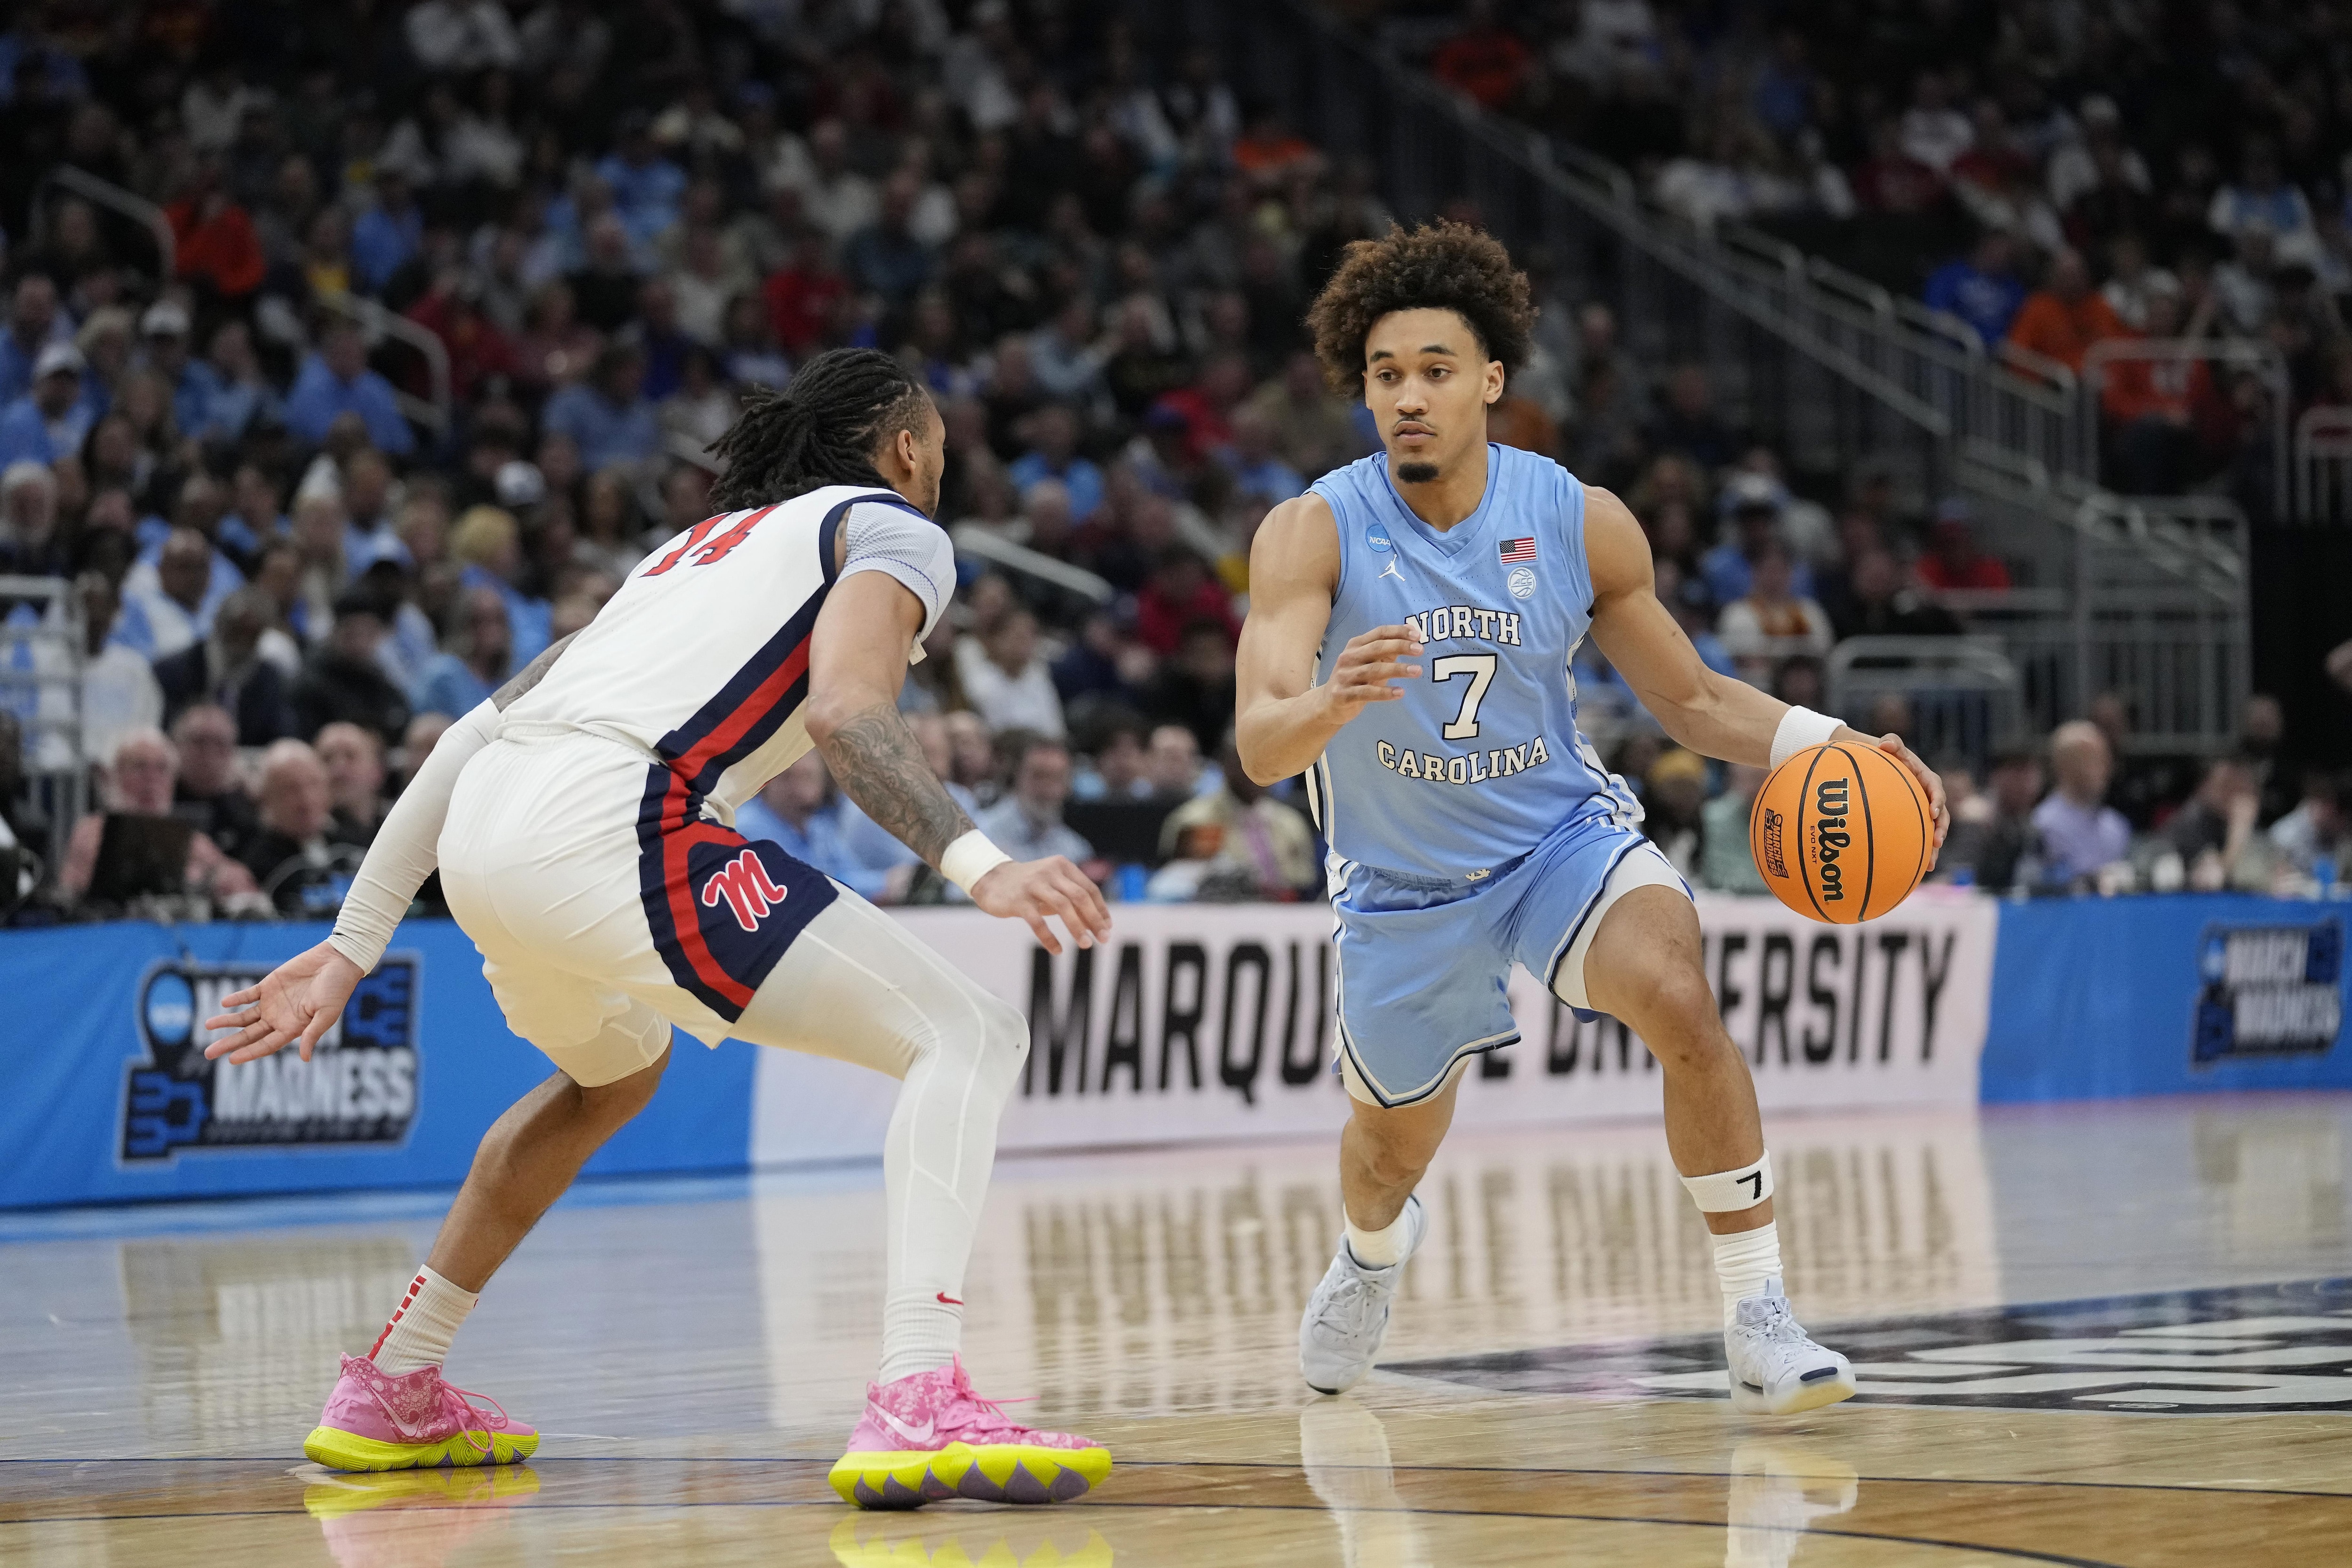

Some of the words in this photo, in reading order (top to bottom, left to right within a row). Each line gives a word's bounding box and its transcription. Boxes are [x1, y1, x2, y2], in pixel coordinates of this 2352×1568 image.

[637, 503, 781, 578] 14
[1369, 536, 1391, 546] NCAA
[1405, 605, 1521, 646] NORTH
[1432, 653, 1497, 740] 7
[1376, 736, 1549, 785] CAROLINA
[1766, 828, 1780, 877] MADNESS
[1773, 825, 1782, 863] MARCH
[1817, 778, 1850, 902] Wilson
[1736, 1171, 1762, 1200] 7
